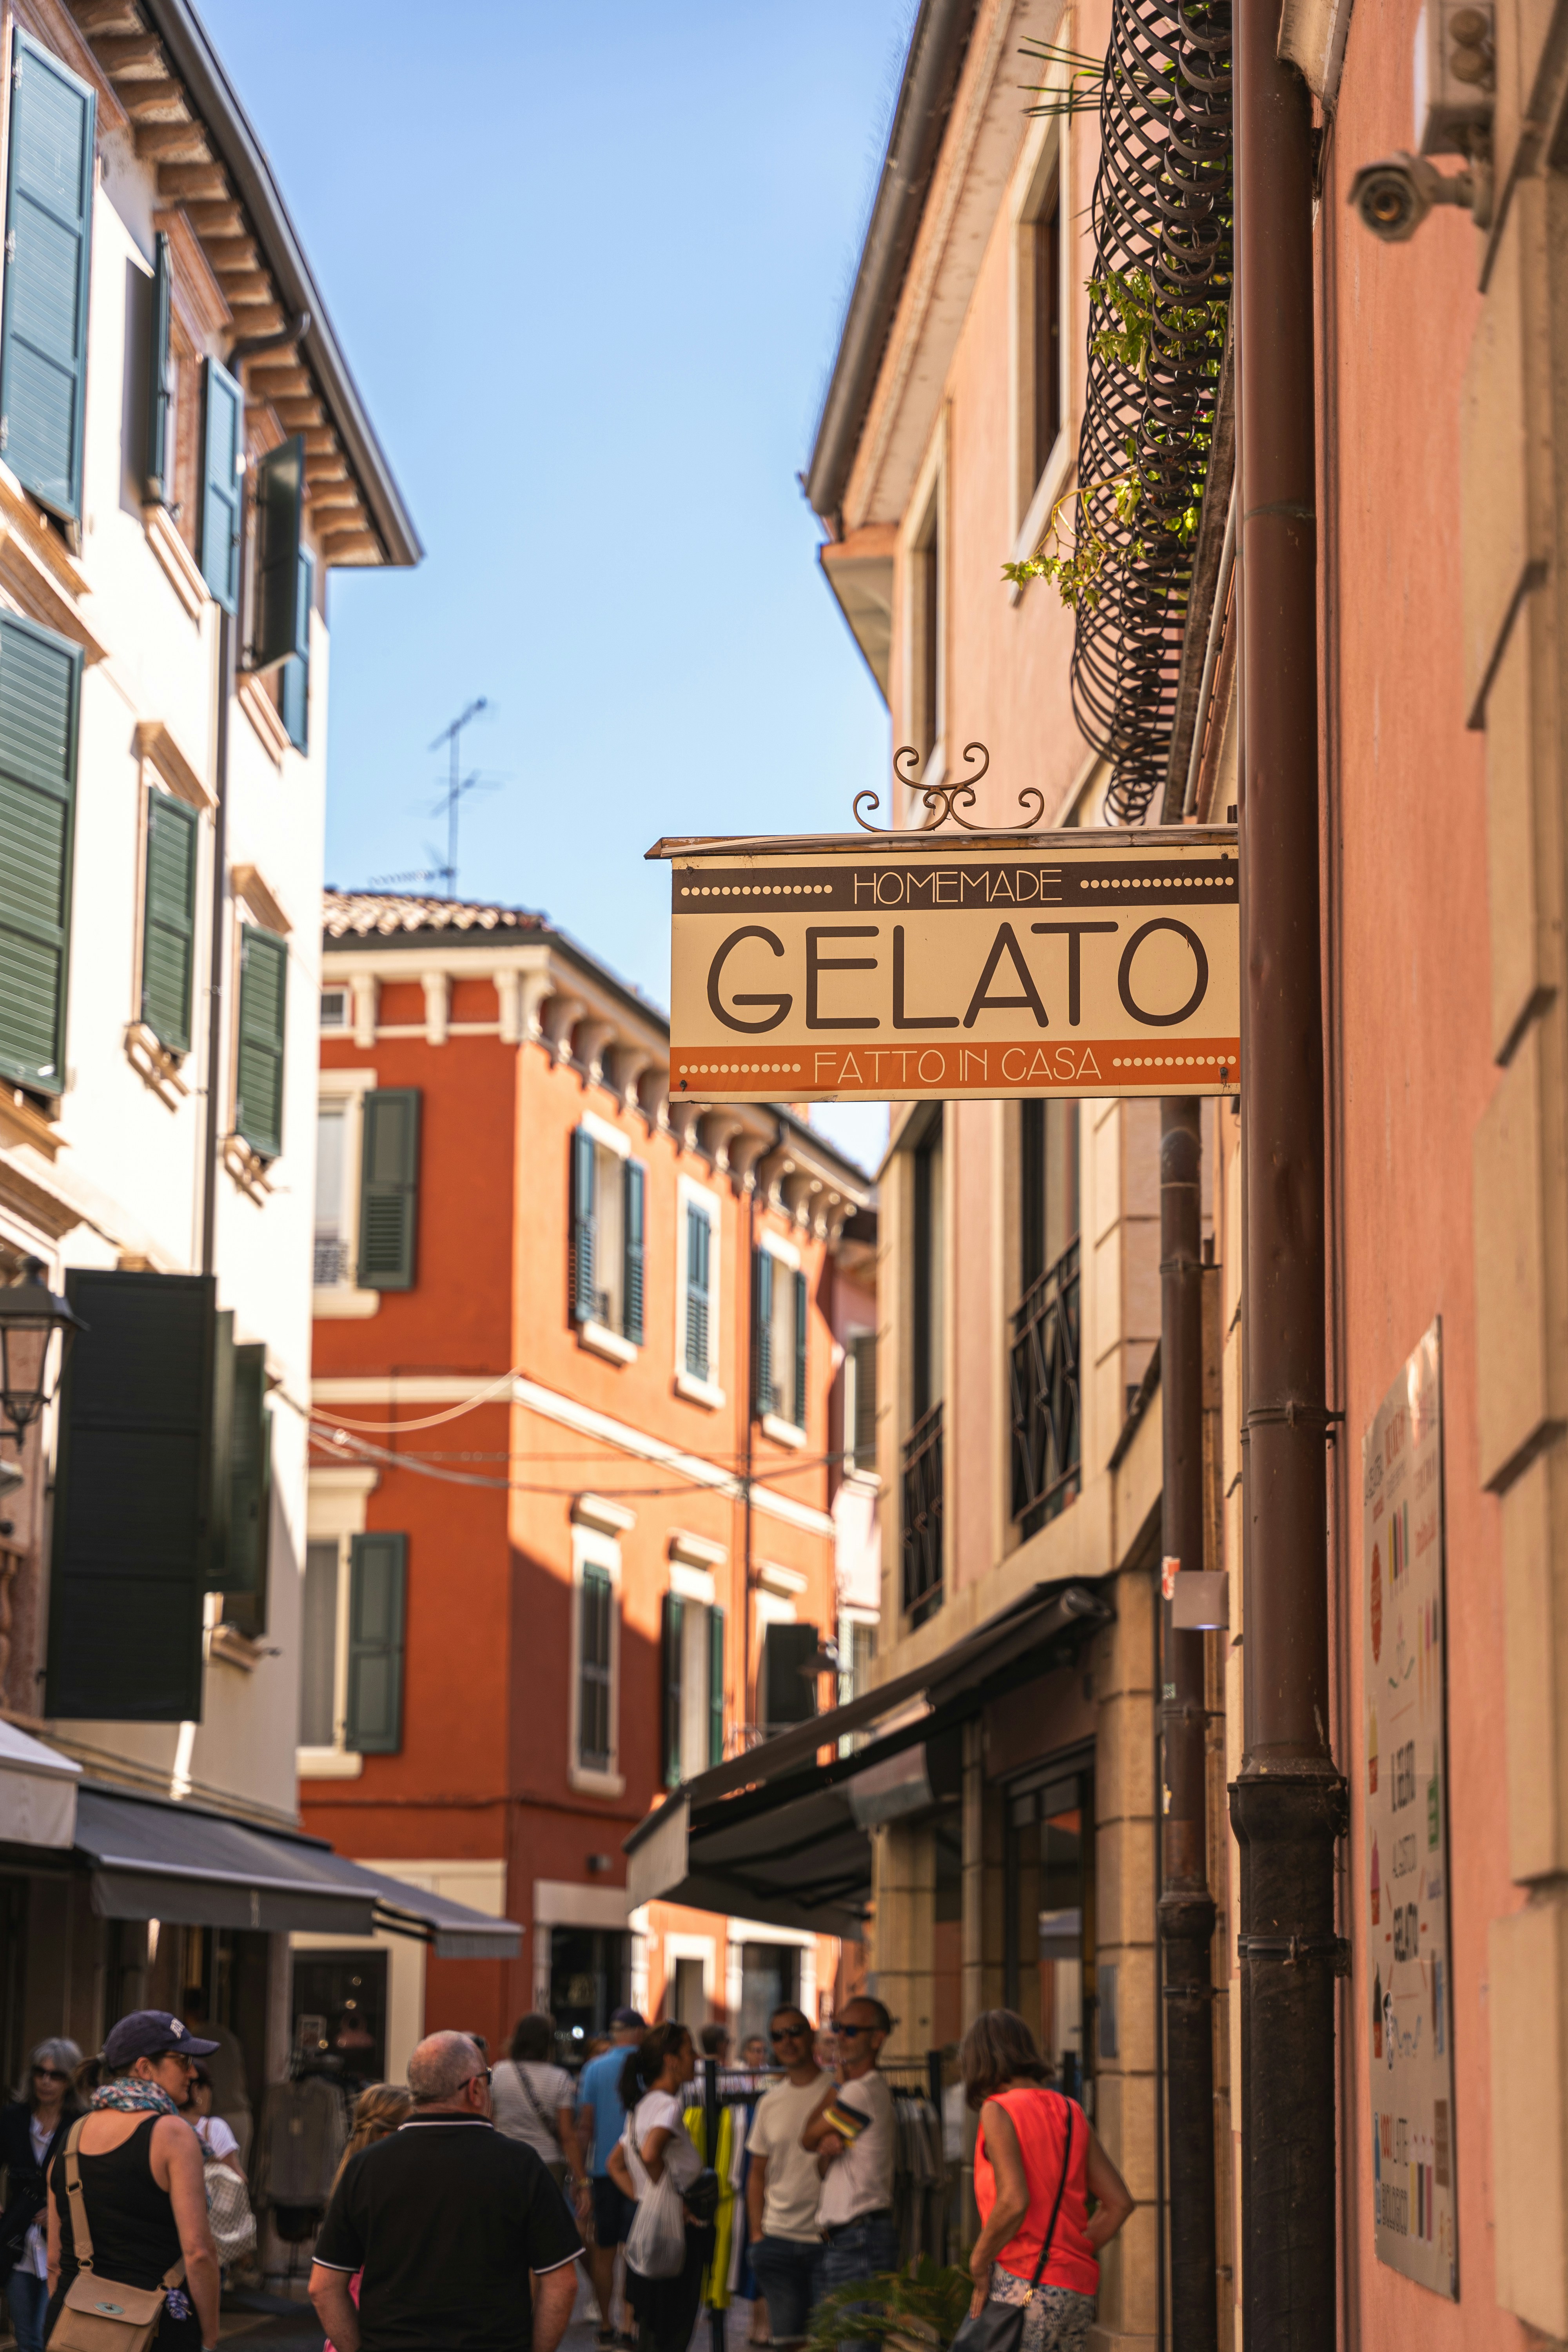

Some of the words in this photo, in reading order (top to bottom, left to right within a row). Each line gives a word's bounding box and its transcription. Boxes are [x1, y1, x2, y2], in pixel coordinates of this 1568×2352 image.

[854, 869, 1062, 904] HOMEMADE
[707, 917, 1209, 1034] GELATO
[815, 1050, 945, 1083] FATTO
[960, 1049, 987, 1081] IN
[1002, 1047, 1102, 1081] CASA
